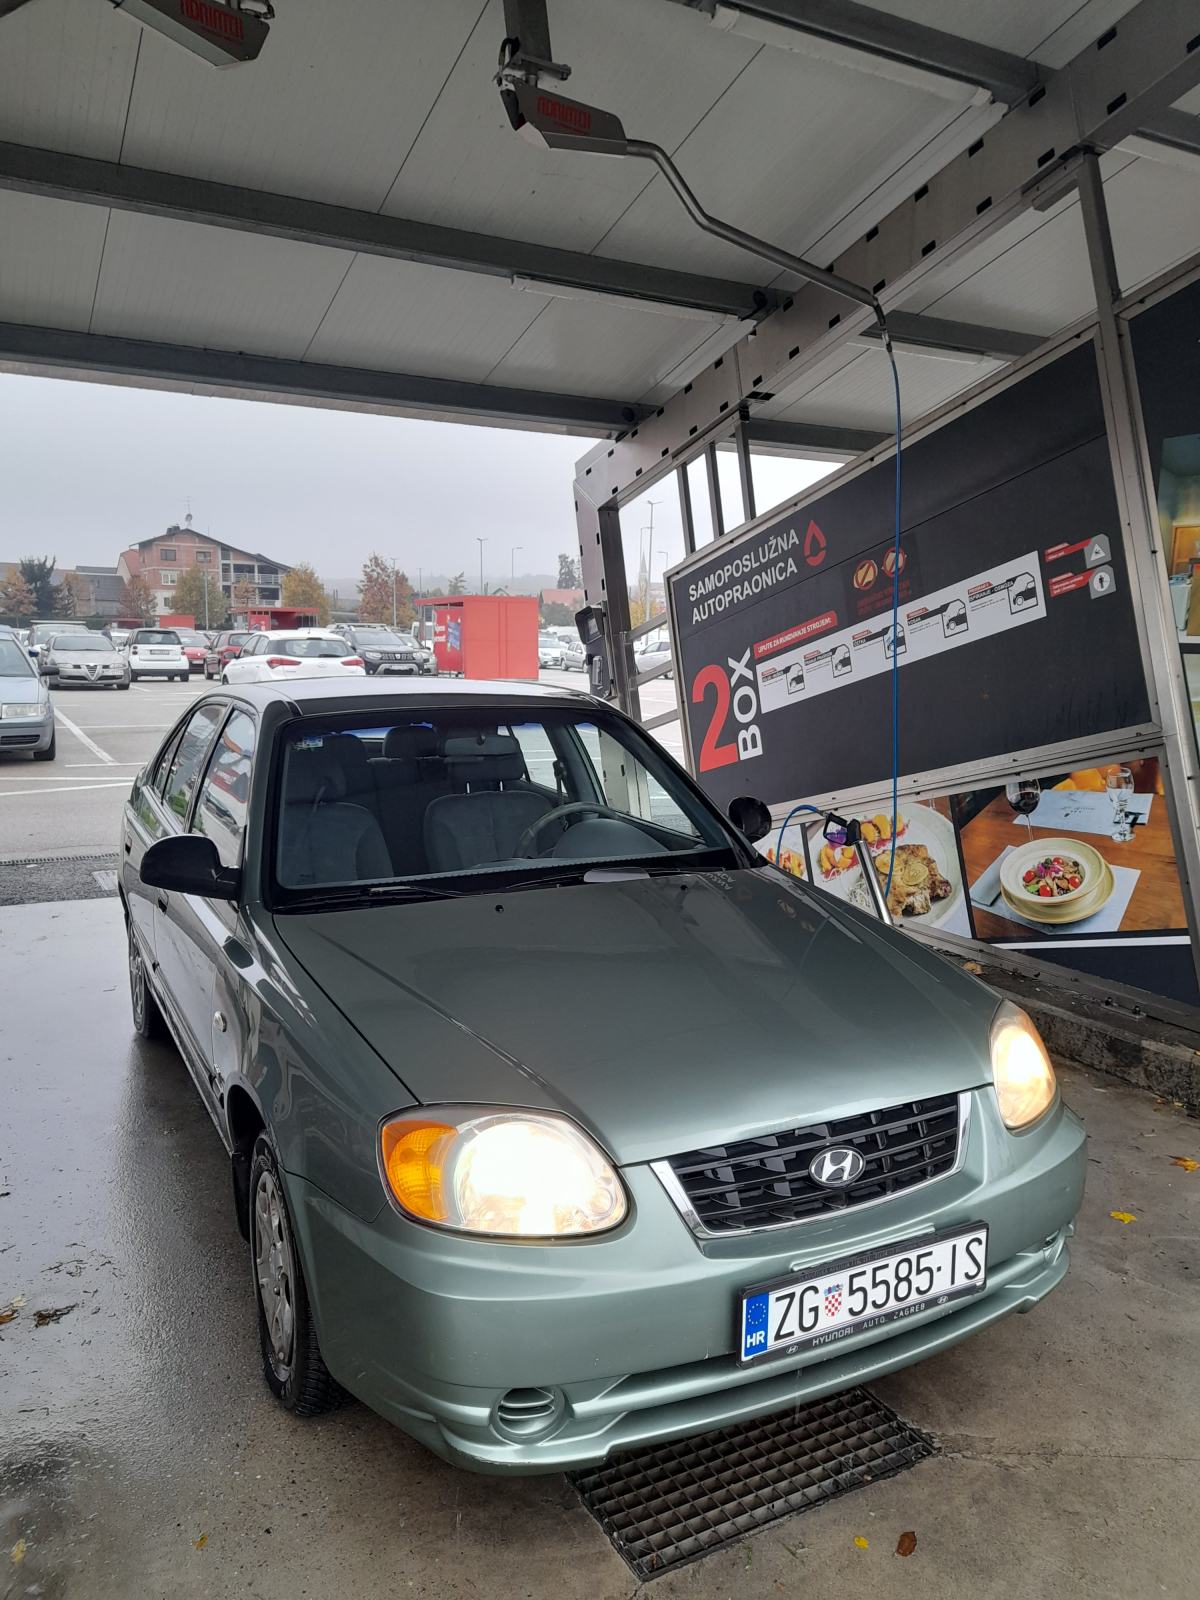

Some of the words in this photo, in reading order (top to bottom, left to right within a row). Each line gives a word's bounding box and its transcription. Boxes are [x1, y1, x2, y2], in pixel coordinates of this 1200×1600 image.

[689, 528, 800, 602] SAMOPOSLUŽNA
[692, 557, 798, 625] AUTOPRAONICA
[692, 664, 739, 773] 2
[727, 646, 763, 760] BOX
[746, 1330, 765, 1349] HR
[773, 1285, 819, 1342] ZG
[812, 1327, 854, 1347] HYUNDAI
[862, 1317, 885, 1329] AUTO
[893, 1303, 925, 1320] ZAGREB
